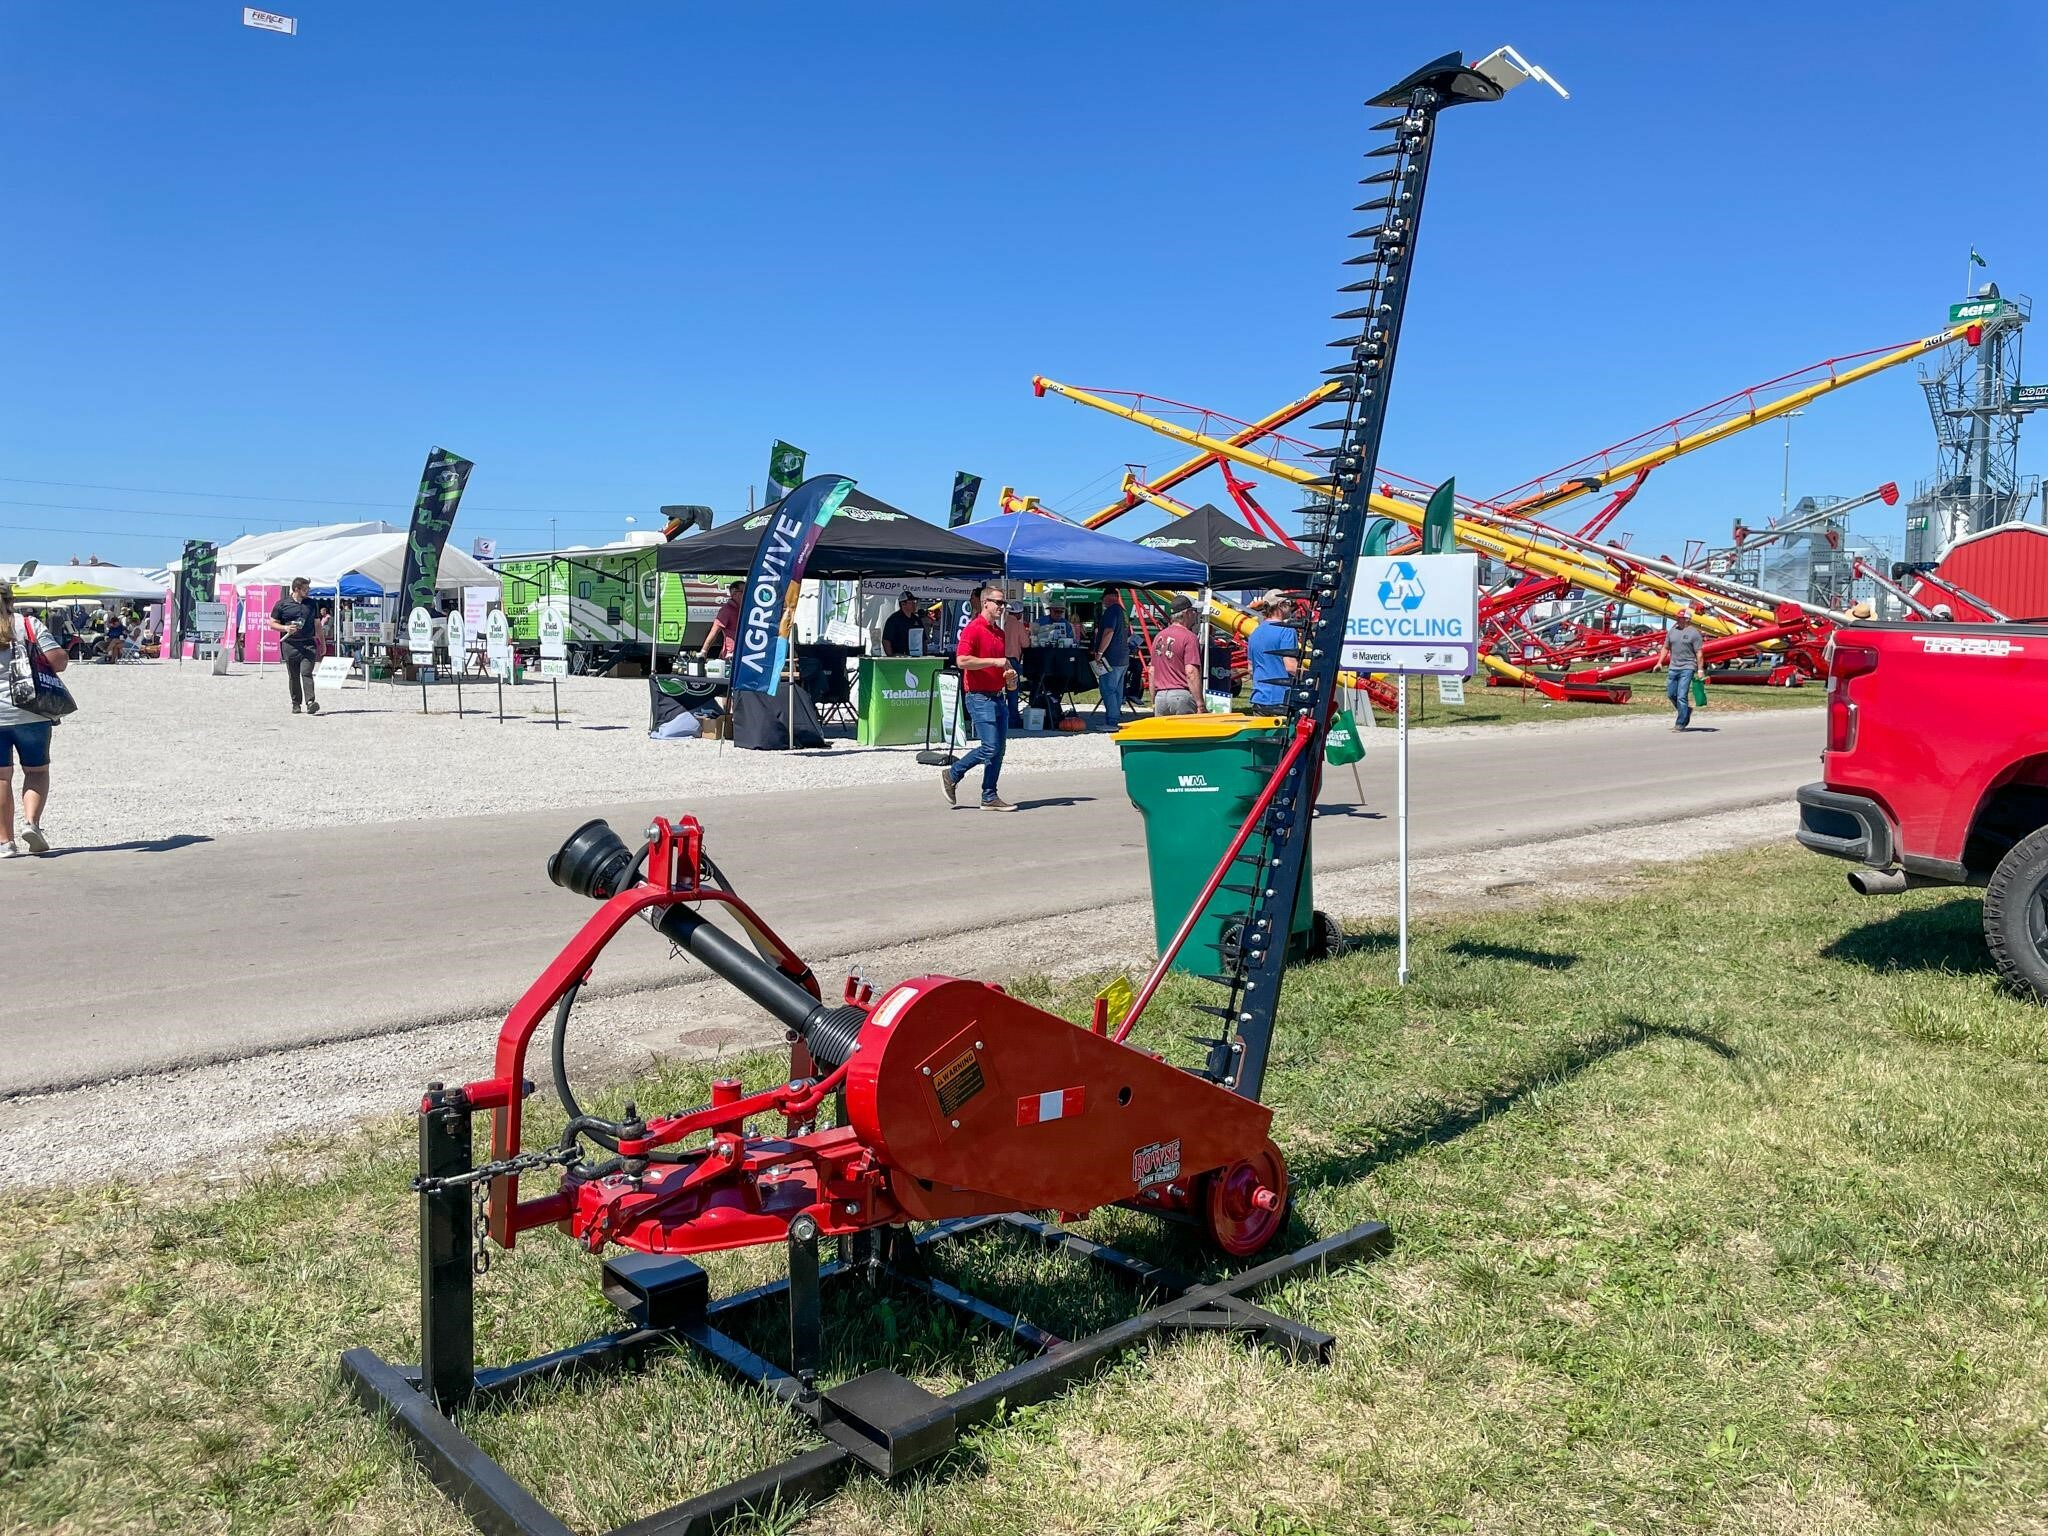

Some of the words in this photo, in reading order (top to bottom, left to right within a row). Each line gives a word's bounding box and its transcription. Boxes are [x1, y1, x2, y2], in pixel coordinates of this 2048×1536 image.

[1957, 304, 1984, 318] AGI
[1923, 334, 1942, 348] AGI
[741, 511, 802, 674] AGROVIVE
[902, 584, 921, 592] Ocean
[922, 585, 944, 593] Mineral
[944, 586, 972, 595] Concentr
[1346, 618, 1462, 637] RECYCLING
[1358, 651, 1391, 661] Maverick
[1178, 775, 1207, 787] WM
[942, 1053, 974, 1081] WARNING
[1134, 1140, 1181, 1181] ROWSE
